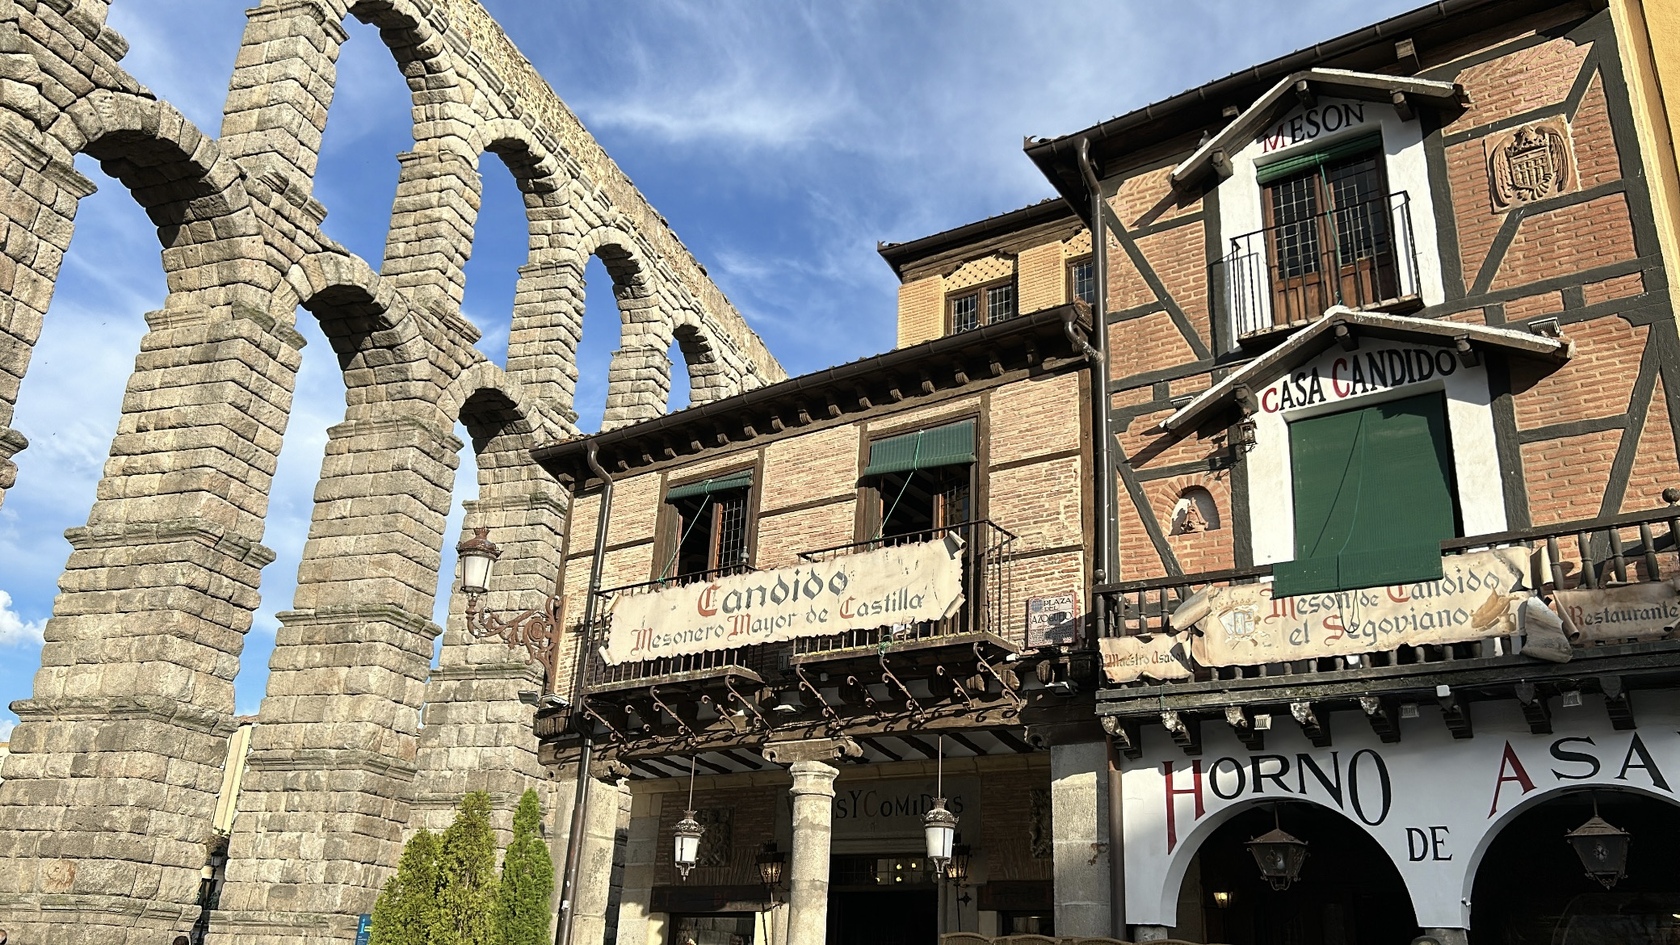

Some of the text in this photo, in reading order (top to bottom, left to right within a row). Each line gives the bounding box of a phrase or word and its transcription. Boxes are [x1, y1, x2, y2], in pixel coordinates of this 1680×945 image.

[1262, 102, 1365, 154] MESON
[1261, 348, 1457, 414] CASA CANDIDO
[697, 567, 849, 618] Candido
[1043, 597, 1072, 607] PLAZA
[1359, 590, 1379, 608] de
[1386, 567, 1501, 604] Candido
[1568, 600, 1679, 626] Restaurante
[630, 587, 927, 656] Mesonero Mayor de Castilla
[1289, 607, 1469, 647] el Segoviano
[1161, 731, 1680, 862] HORNO DE ASA
